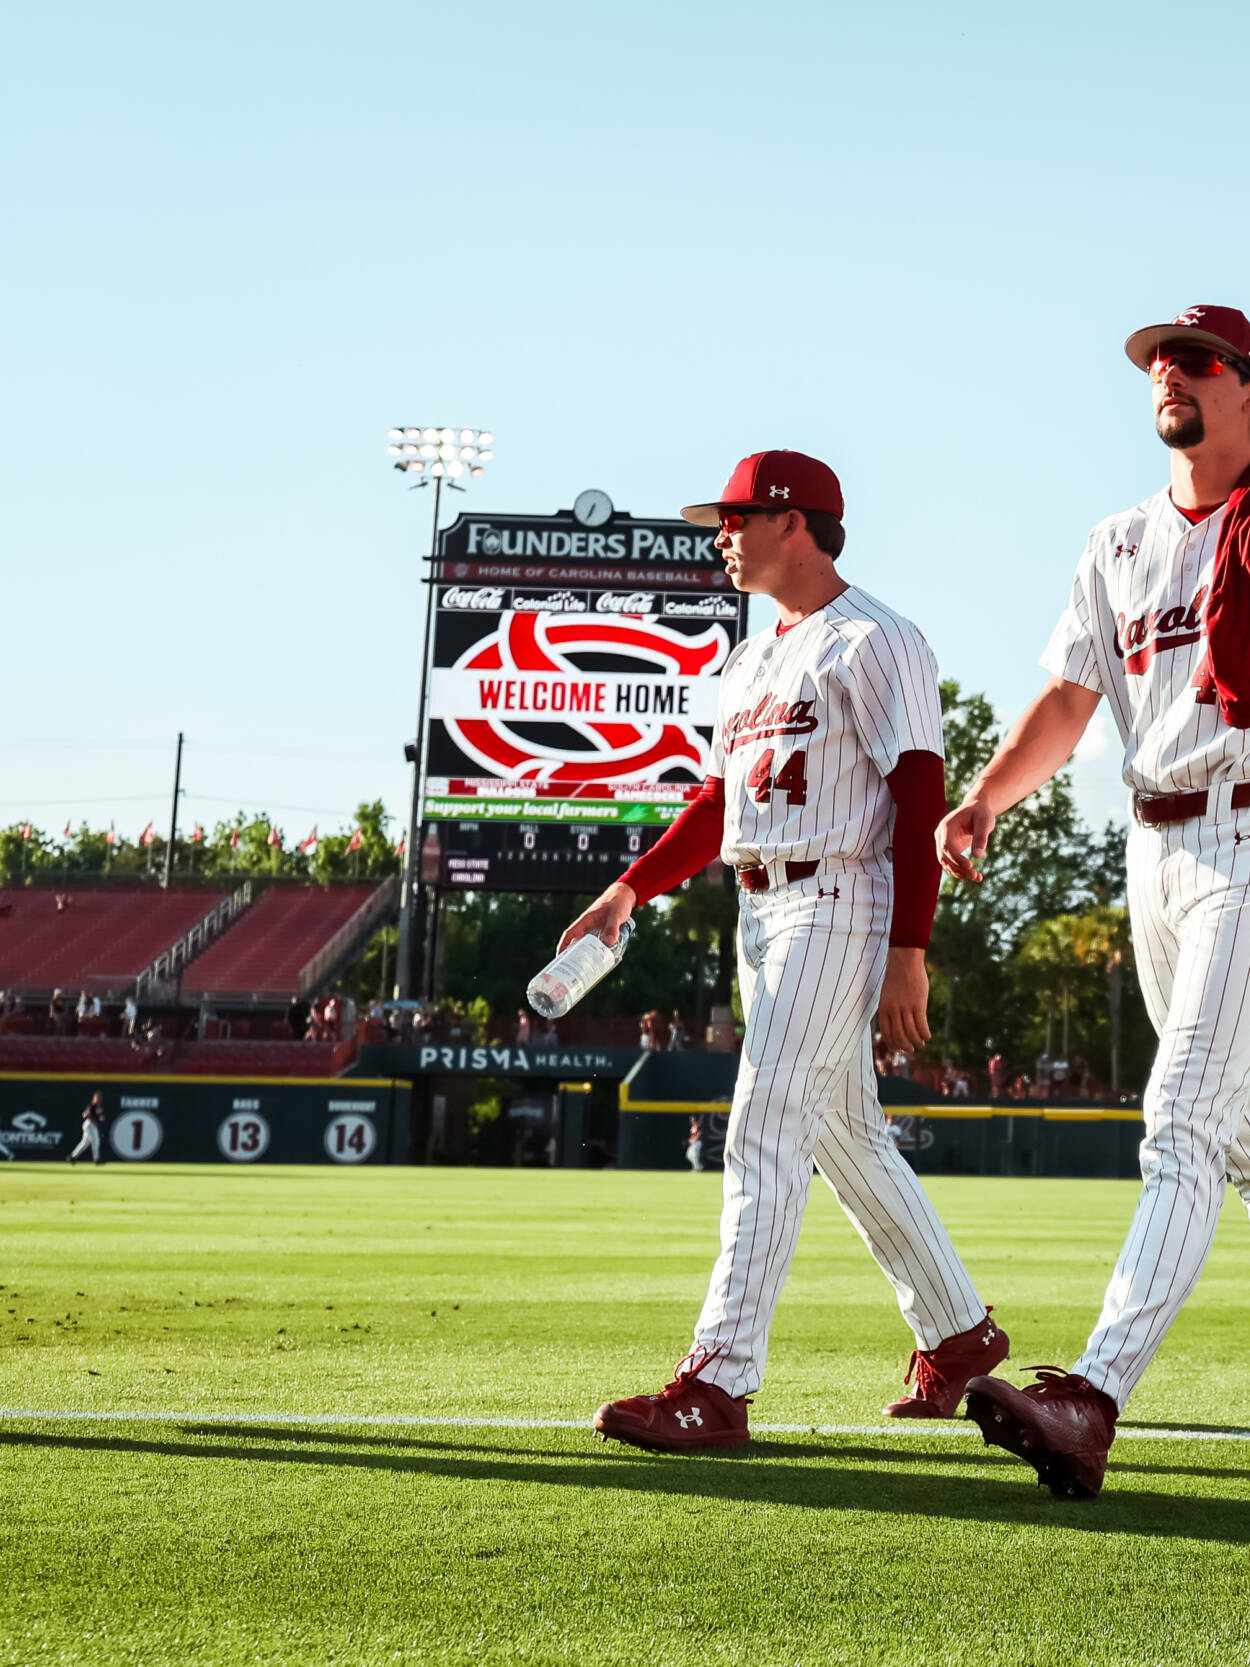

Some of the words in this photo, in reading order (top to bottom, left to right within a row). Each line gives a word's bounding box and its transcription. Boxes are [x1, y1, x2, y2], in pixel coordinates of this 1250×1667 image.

[467, 523, 626, 559] FOUNDERS
[631, 529, 714, 561] PARK
[478, 566, 521, 577] HOME
[524, 567, 545, 578] OF
[549, 568, 623, 580] CAROLINA
[627, 571, 701, 583] BASEBALL
[513, 597, 564, 611] Colonial
[564, 597, 586, 611] Life
[665, 602, 714, 616] Colonial
[715, 602, 737, 616] Life
[479, 679, 606, 713] WELCOME
[616, 683, 689, 714] HOME
[747, 749, 807, 805] 44
[614, 790, 684, 802] GAMECOCKS
[425, 799, 485, 816] Support
[484, 803, 522, 818] your
[522, 801, 558, 816] local
[555, 802, 618, 819] farmers
[459, 823, 479, 832] MPH
[519, 824, 539, 833] BALL
[569, 826, 599, 835] STRIKE
[626, 827, 643, 836] OUT
[524, 833, 535, 849] 0
[577, 834, 589, 850] 0
[628, 835, 640, 851] 0
[420, 1048, 530, 1070] PRISMA
[0, 1131, 63, 1145] ONTRACT
[131, 1120, 144, 1151] 1
[228, 1121, 261, 1152] 13
[335, 1123, 366, 1154] 14
